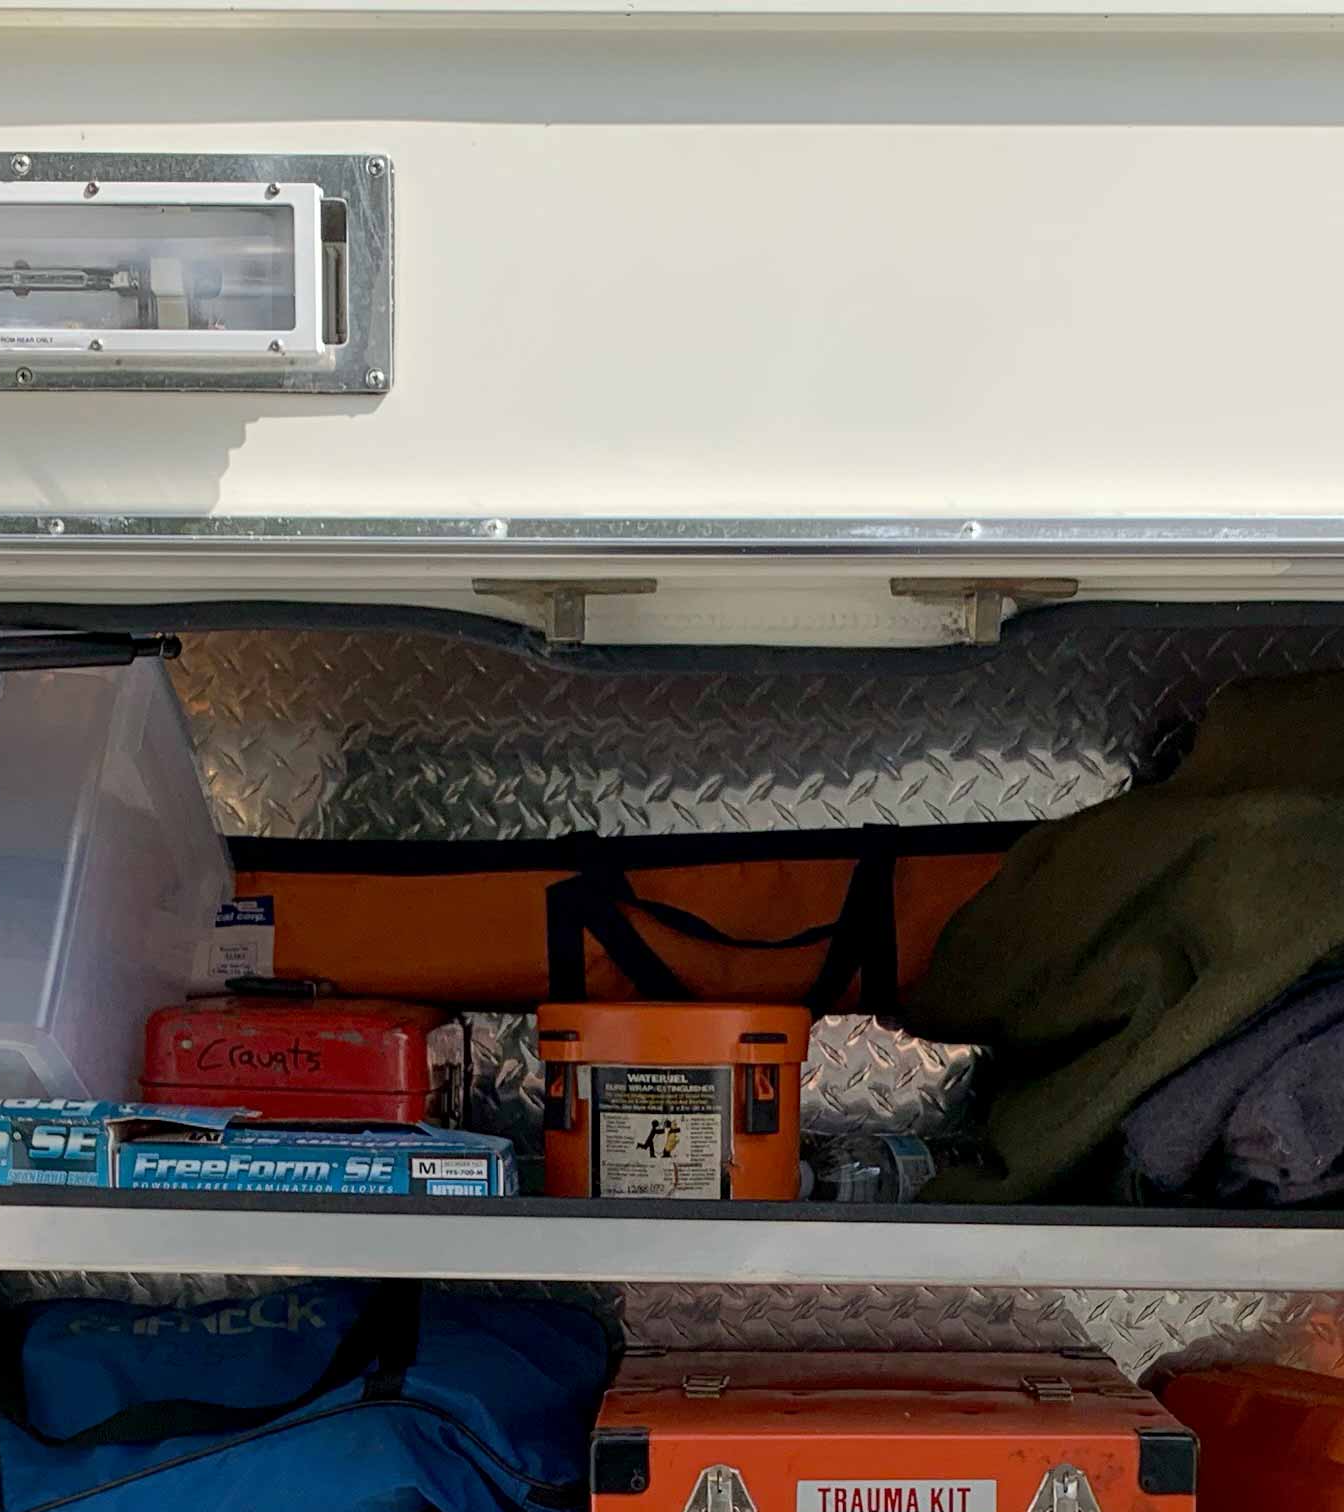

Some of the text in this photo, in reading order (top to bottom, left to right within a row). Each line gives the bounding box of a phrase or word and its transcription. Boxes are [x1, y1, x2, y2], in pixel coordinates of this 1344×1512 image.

[29, 1125, 101, 1161] SE
[343, 1155, 395, 1182] SE
[419, 1162, 436, 1175] M
[341, 1185, 395, 1194] GLOVES
